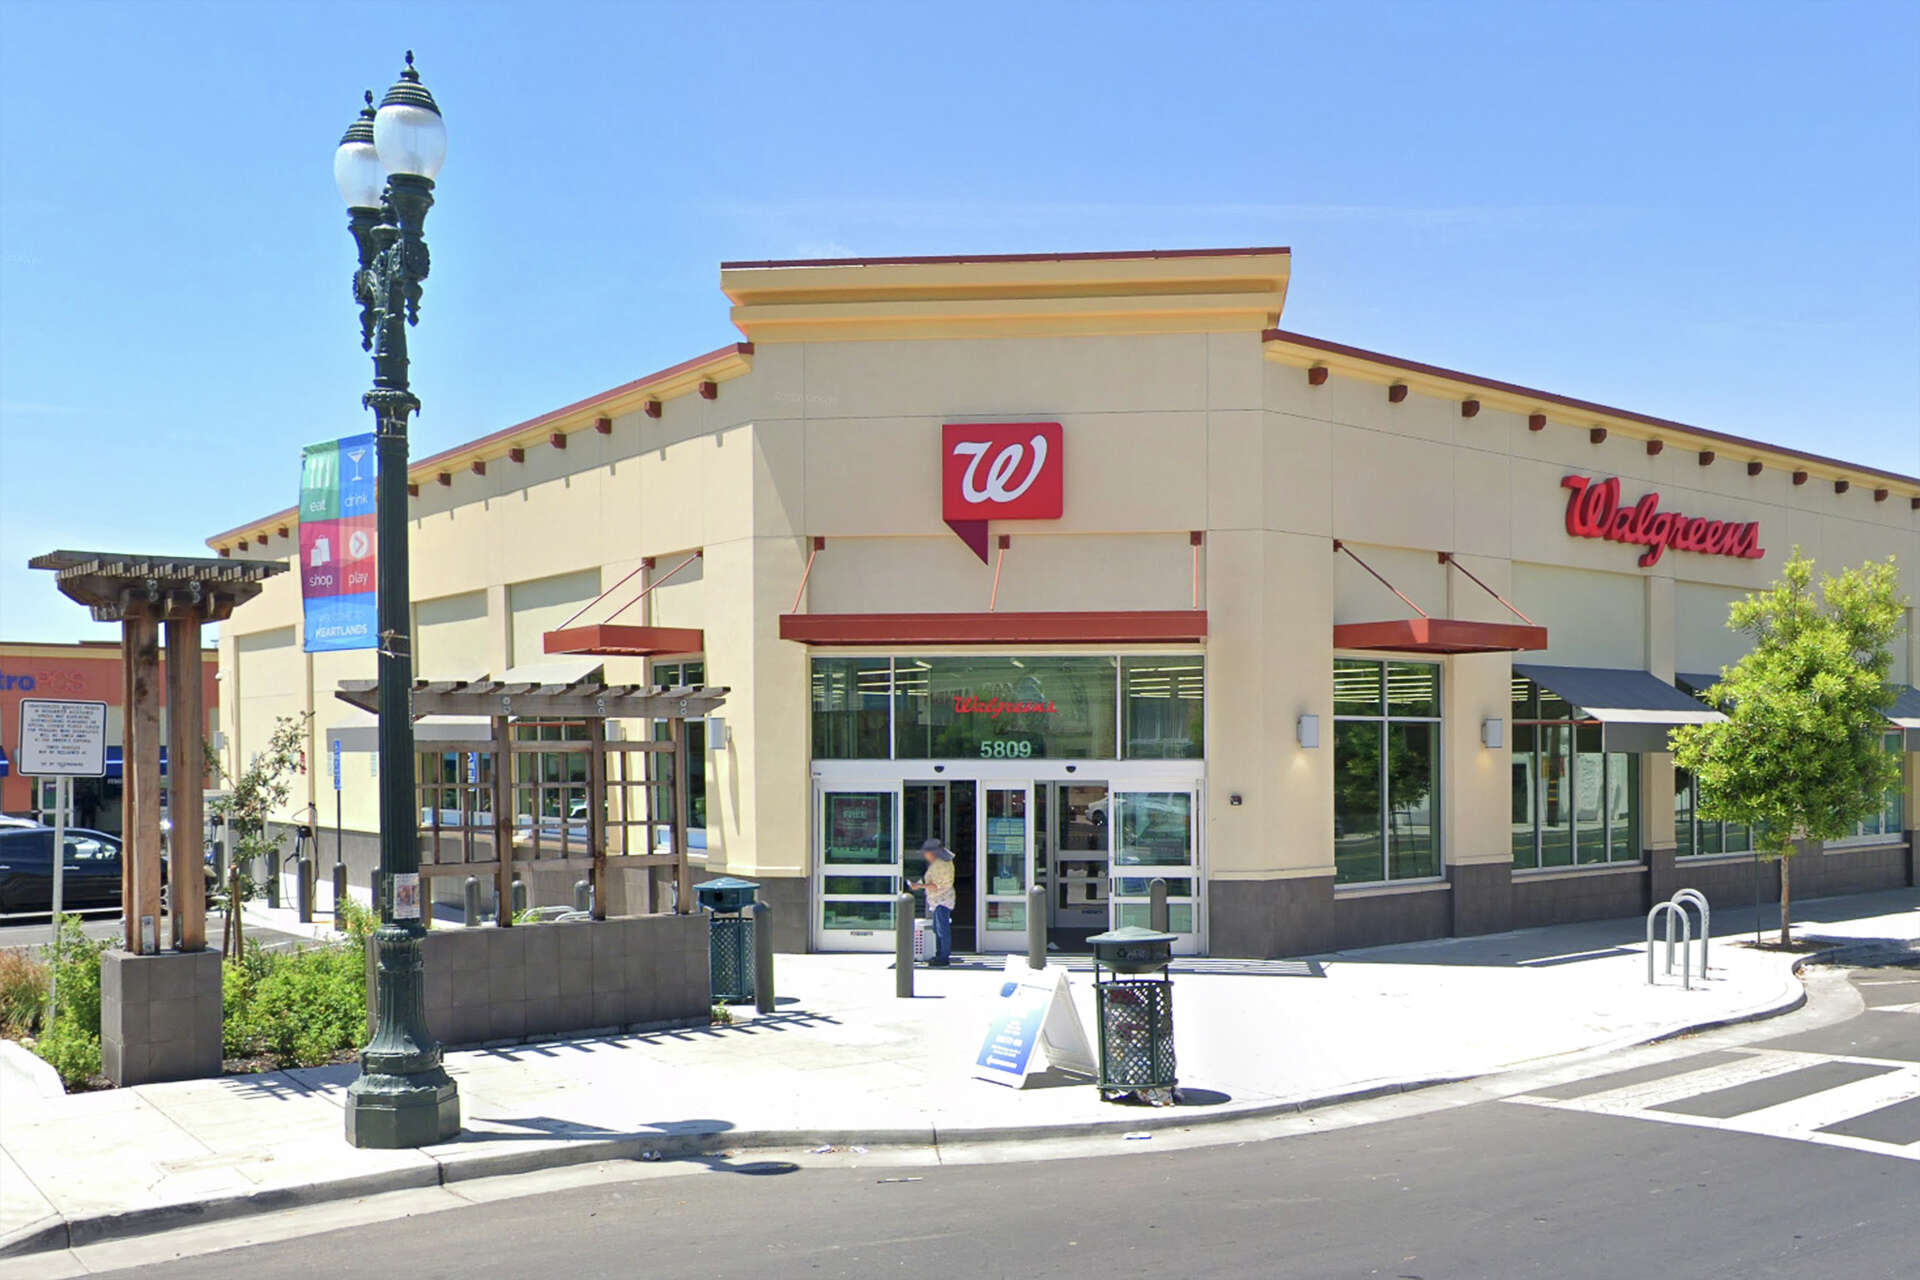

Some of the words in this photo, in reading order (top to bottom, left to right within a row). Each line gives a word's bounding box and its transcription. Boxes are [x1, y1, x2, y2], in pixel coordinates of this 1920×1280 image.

[310, 500, 326, 512] eat
[344, 495, 368, 507] drink
[1560, 474, 1766, 568] Walgreens
[309, 573, 333, 588] shop
[348, 571, 369, 588] play
[953, 695, 1057, 719] Walgreens
[979, 740, 1032, 758] 5809
